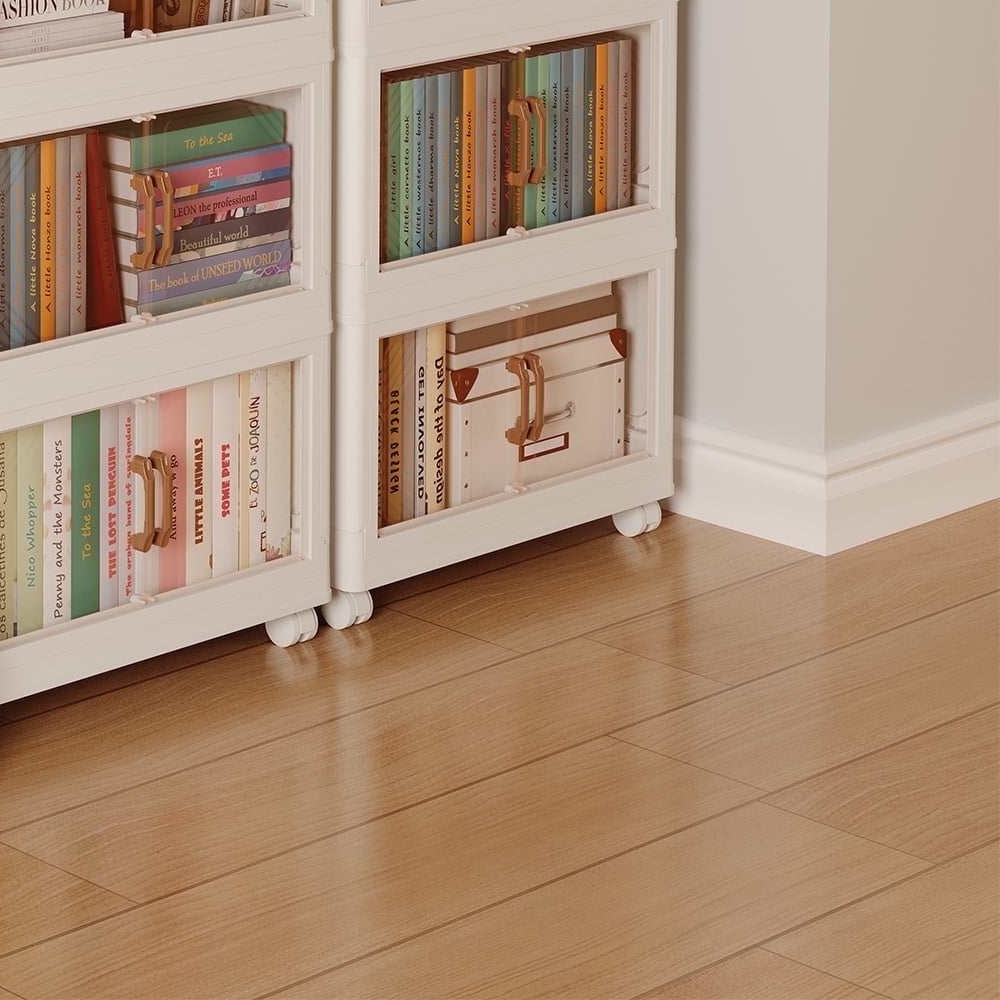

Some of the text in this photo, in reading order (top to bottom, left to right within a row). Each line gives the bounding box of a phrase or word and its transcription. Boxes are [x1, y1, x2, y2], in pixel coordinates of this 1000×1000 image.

[184, 131, 233, 150] To the Sea
[208, 167, 223, 179] E.T.
[588, 186, 592, 195] A
[173, 192, 258, 219] LEON the professional
[454, 216, 459, 224] A
[466, 217, 471, 226] A
[491, 219, 496, 228] A
[180, 225, 249, 252] Beautiful world
[404, 238, 409, 247] A
[148, 250, 283, 293] The book of UNSEED WORLD
[30, 301, 36, 312] A
[45, 303, 51, 313] A
[76, 304, 82, 314] A
[249, 396, 260, 453] JOAQUÍN
[170, 454, 178, 468] go
[126, 481, 132, 495] of
[221, 443, 230, 518] SOME PETS
[195, 438, 203, 545] LITTLE ANIMALS
[108, 446, 116, 579] THE LOST PENGUIN
[53, 439, 65, 618] Penny and the Monsters
[81, 482, 91, 560] To the Sea
[26, 484, 37, 588] Nico Whopper
